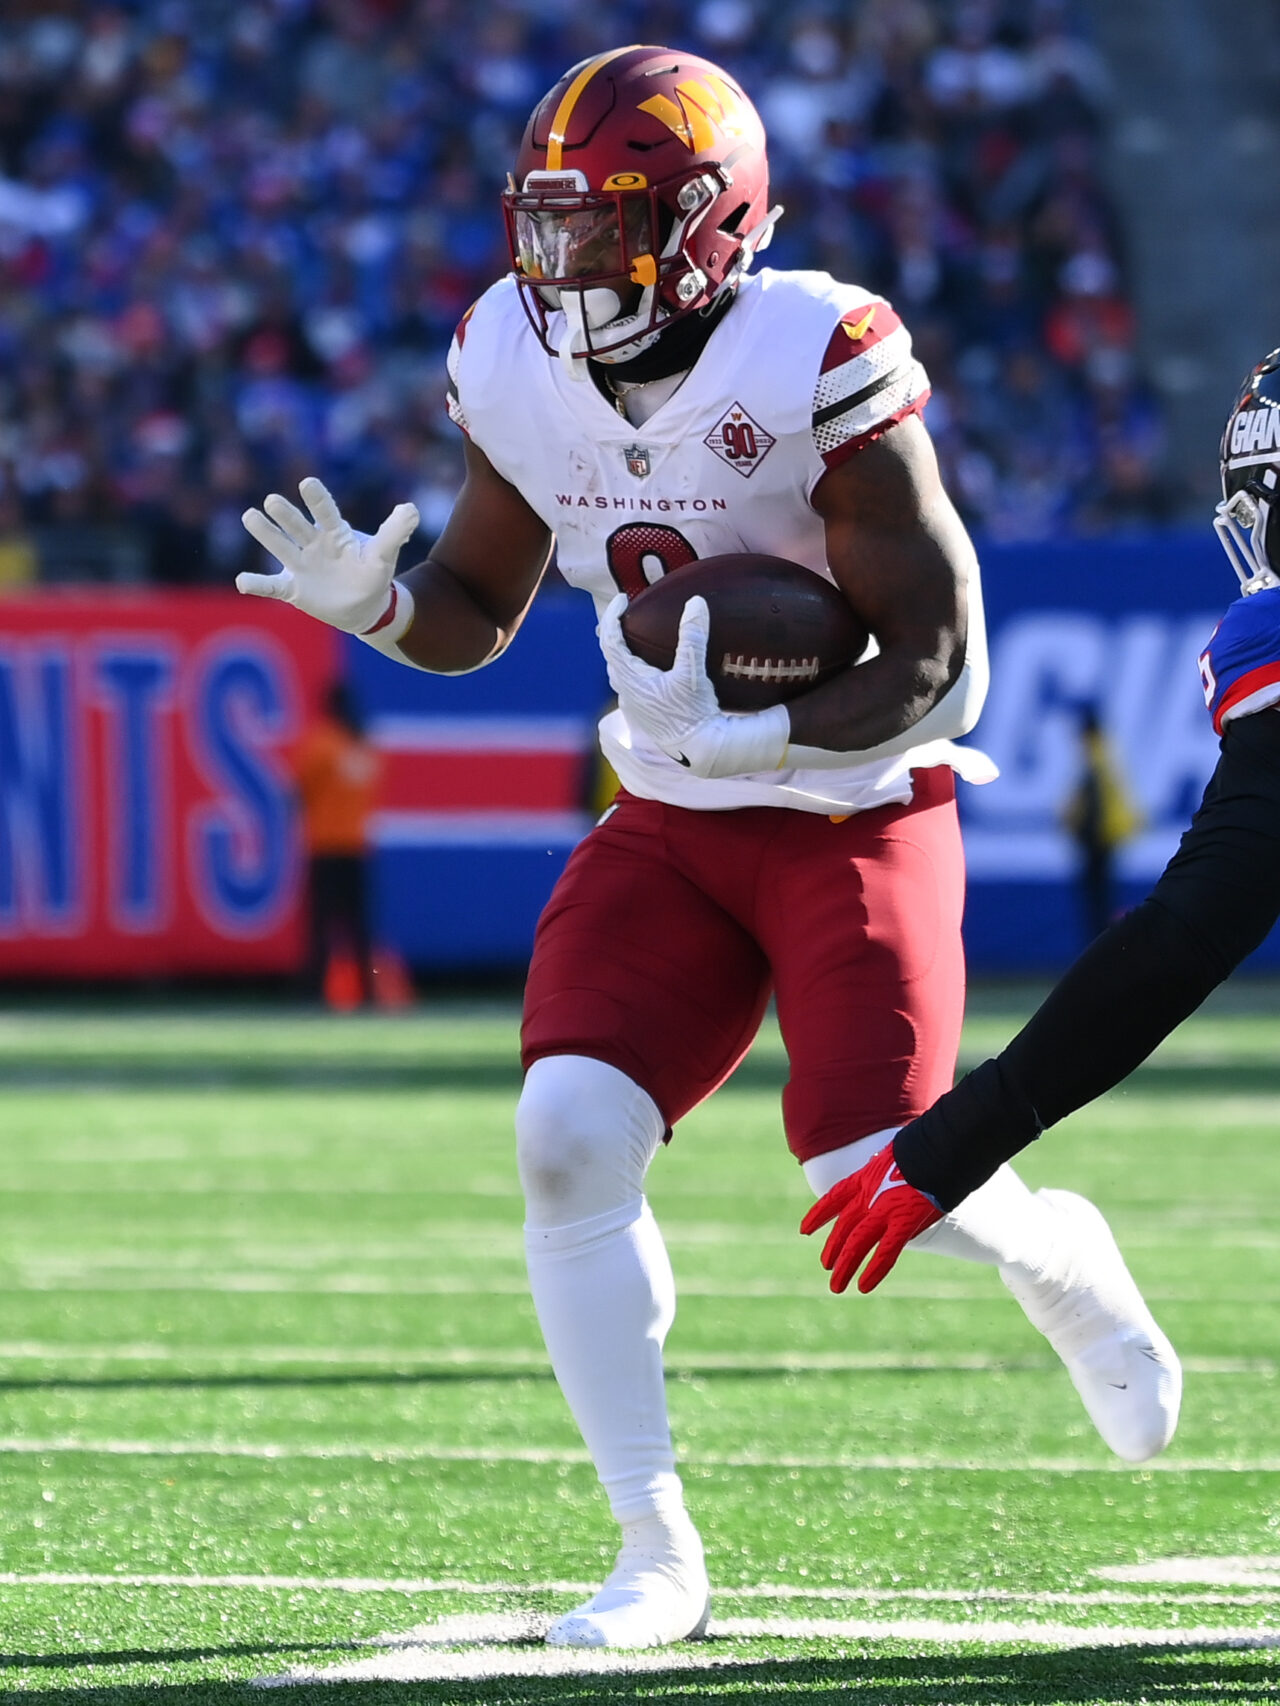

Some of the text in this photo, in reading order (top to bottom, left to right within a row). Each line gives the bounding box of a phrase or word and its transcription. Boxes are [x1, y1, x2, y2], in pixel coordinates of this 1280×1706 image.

[722, 422, 758, 459] 90
[630, 459, 647, 475] NFL
[556, 494, 726, 511] WASHINGTON
